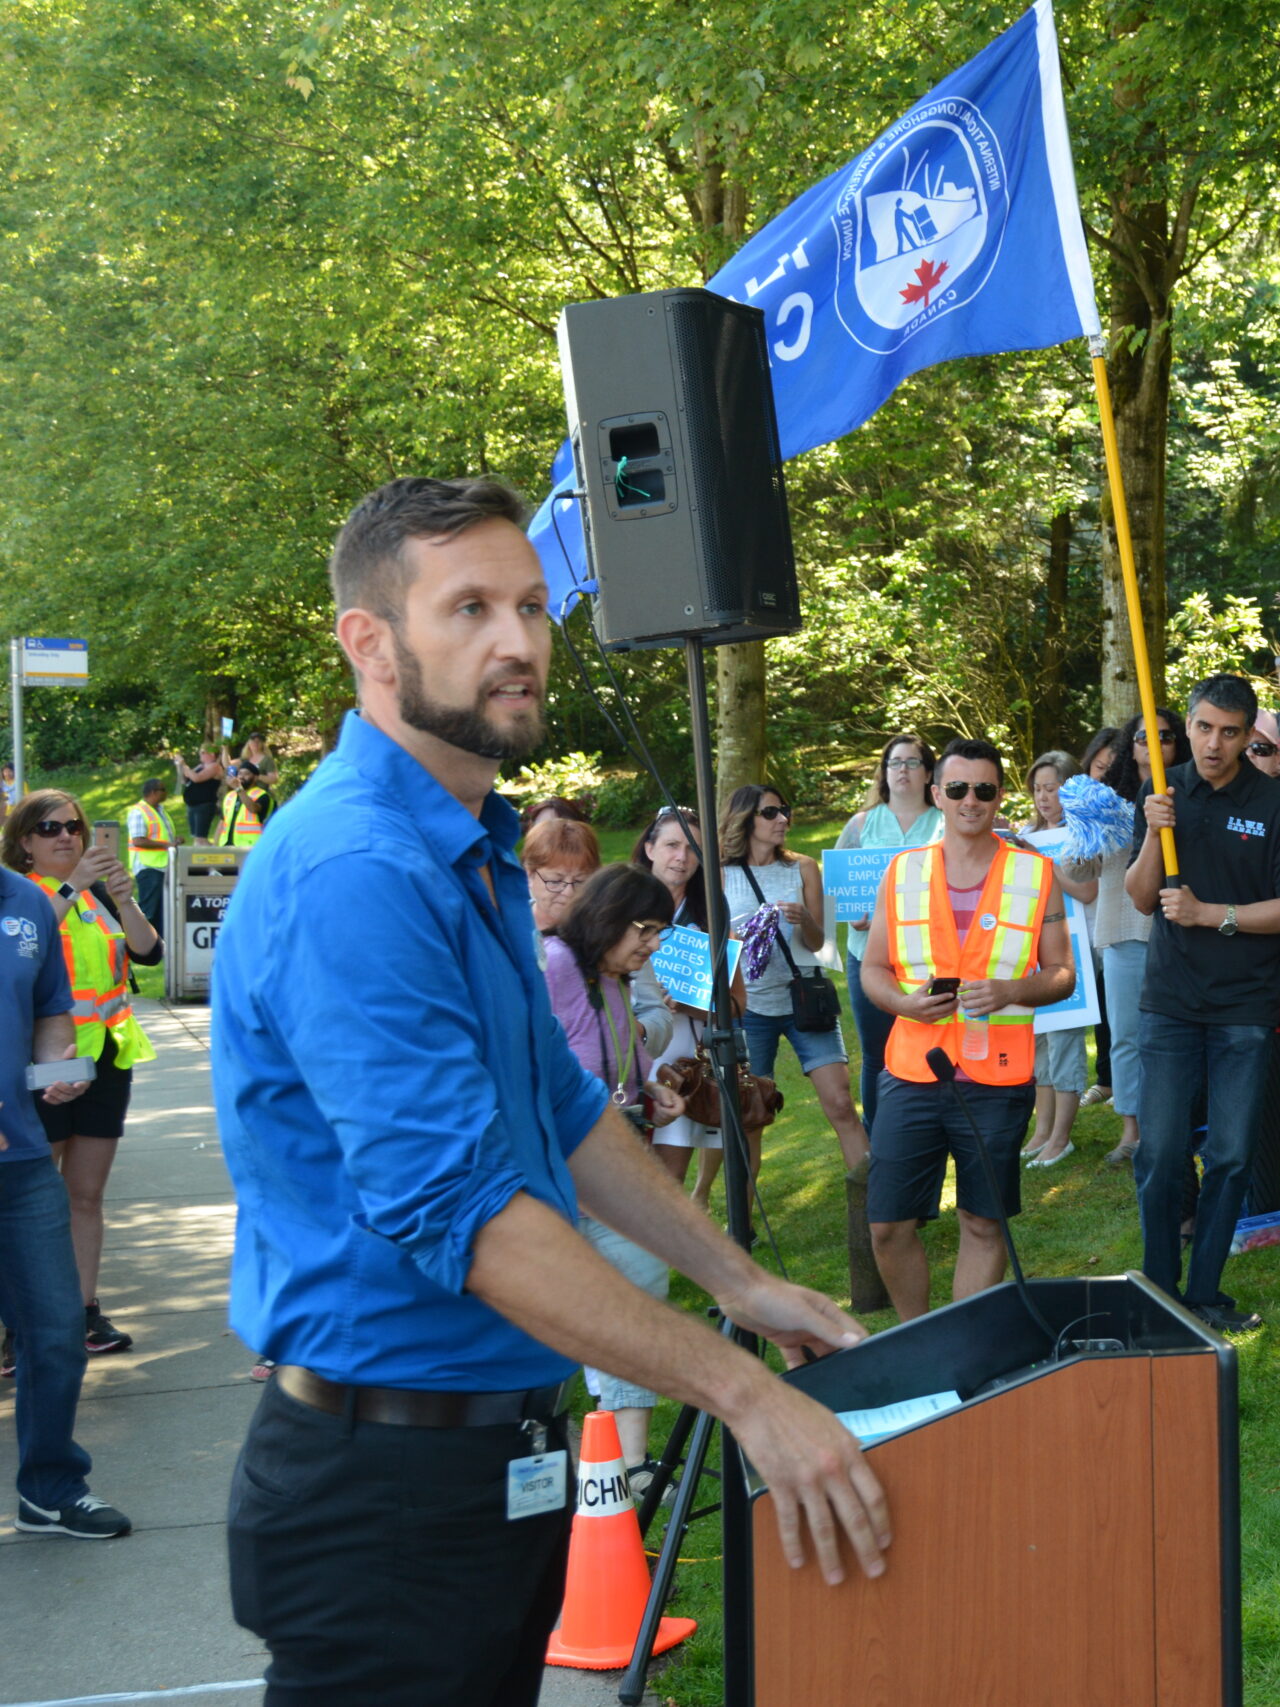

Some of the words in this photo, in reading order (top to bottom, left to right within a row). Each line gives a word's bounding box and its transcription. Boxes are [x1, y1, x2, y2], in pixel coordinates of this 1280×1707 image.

[848, 854, 880, 866] LONG
[828, 886, 858, 897] HAVE
[672, 931, 709, 951] TERM
[694, 971, 714, 985] OU
